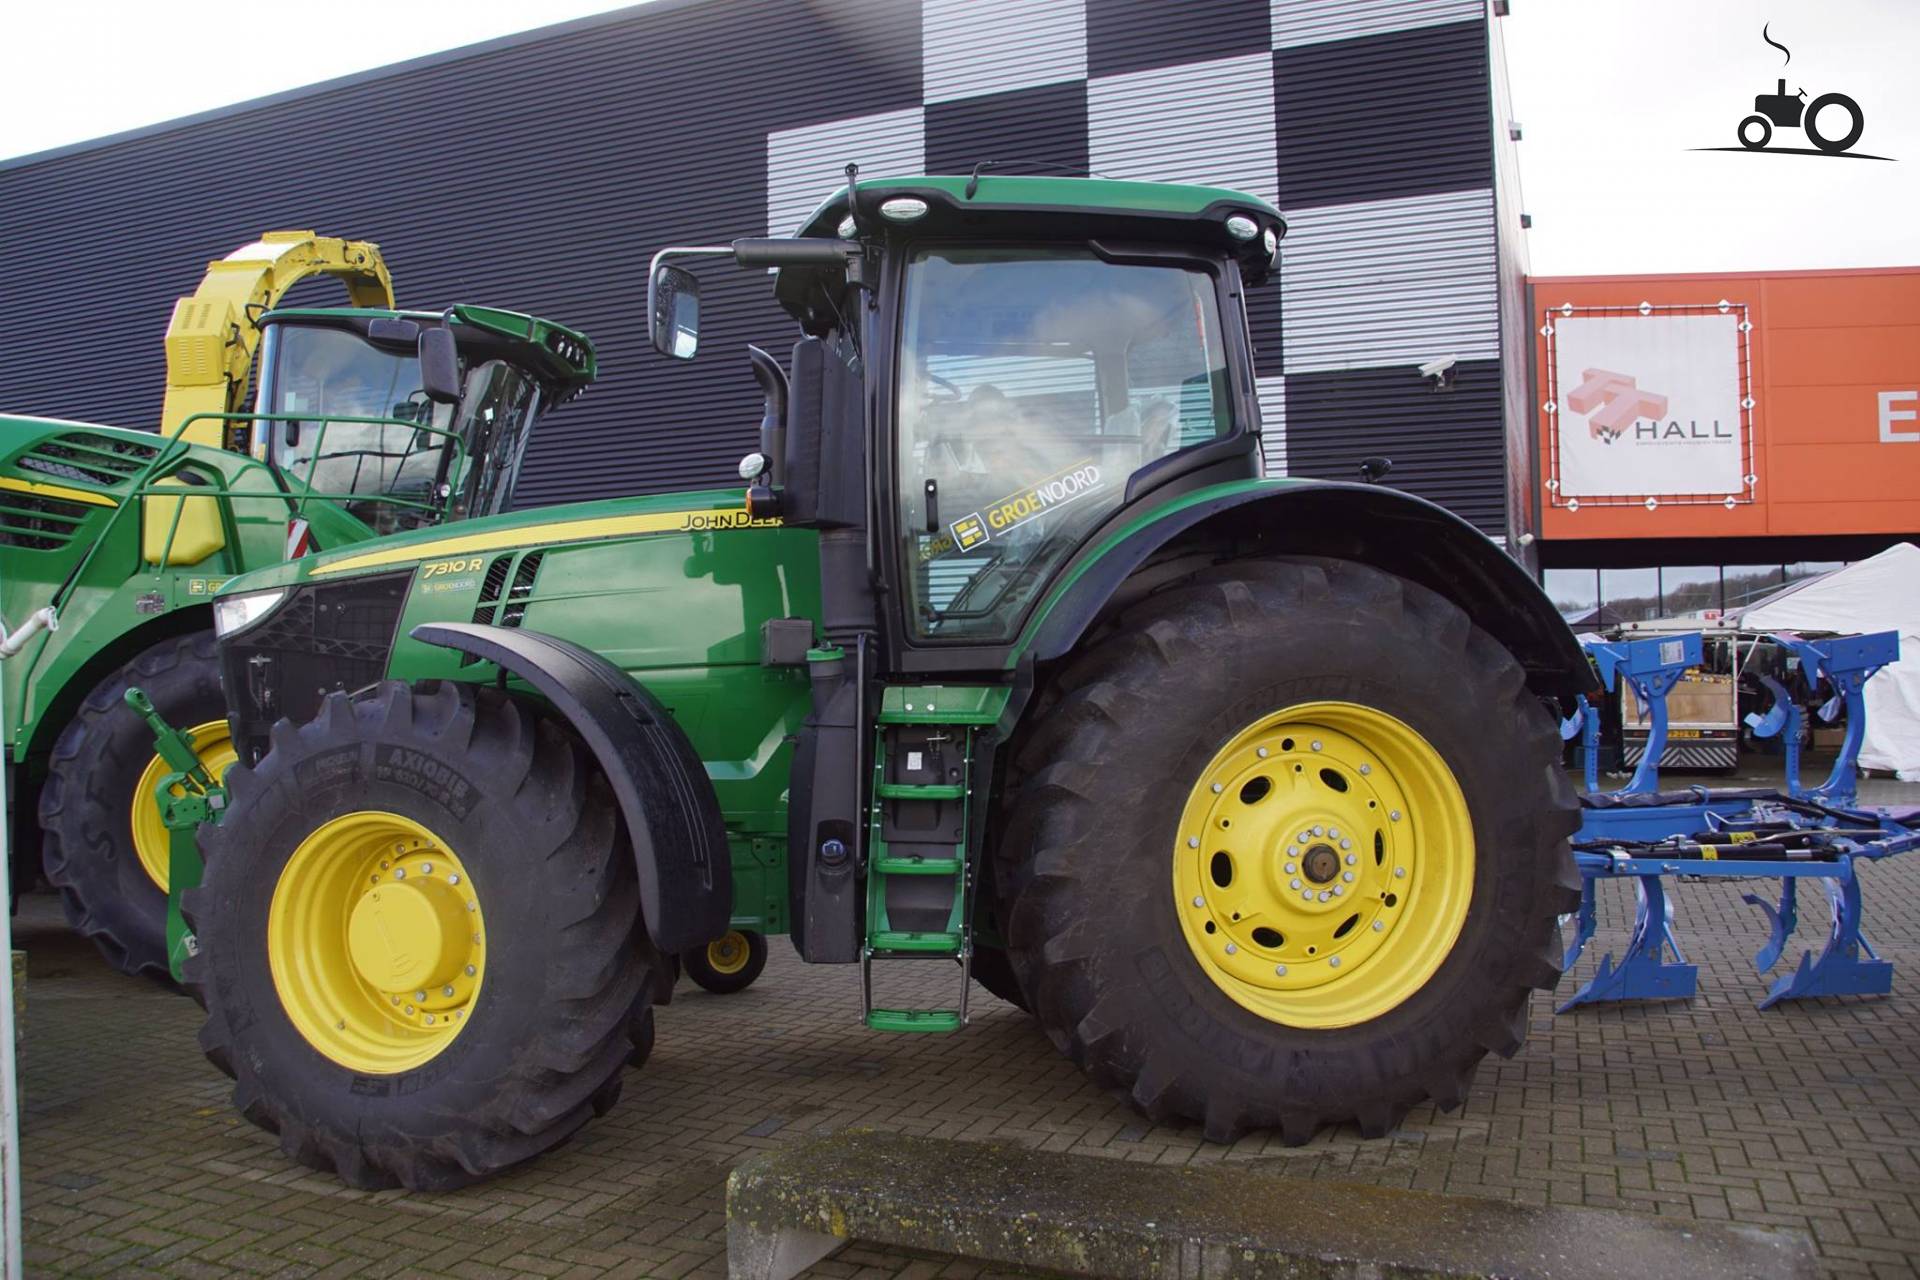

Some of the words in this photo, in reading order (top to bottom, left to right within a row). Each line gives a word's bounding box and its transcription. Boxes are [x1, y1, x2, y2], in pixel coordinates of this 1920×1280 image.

[1635, 420, 1733, 440] HALL
[1878, 391, 1920, 443] E
[987, 465, 1101, 530] GROENOORD
[681, 514, 732, 530] JOHN
[424, 560, 467, 579] 7310
[468, 558, 483, 572] R
[388, 747, 470, 801] AXIOBIB
